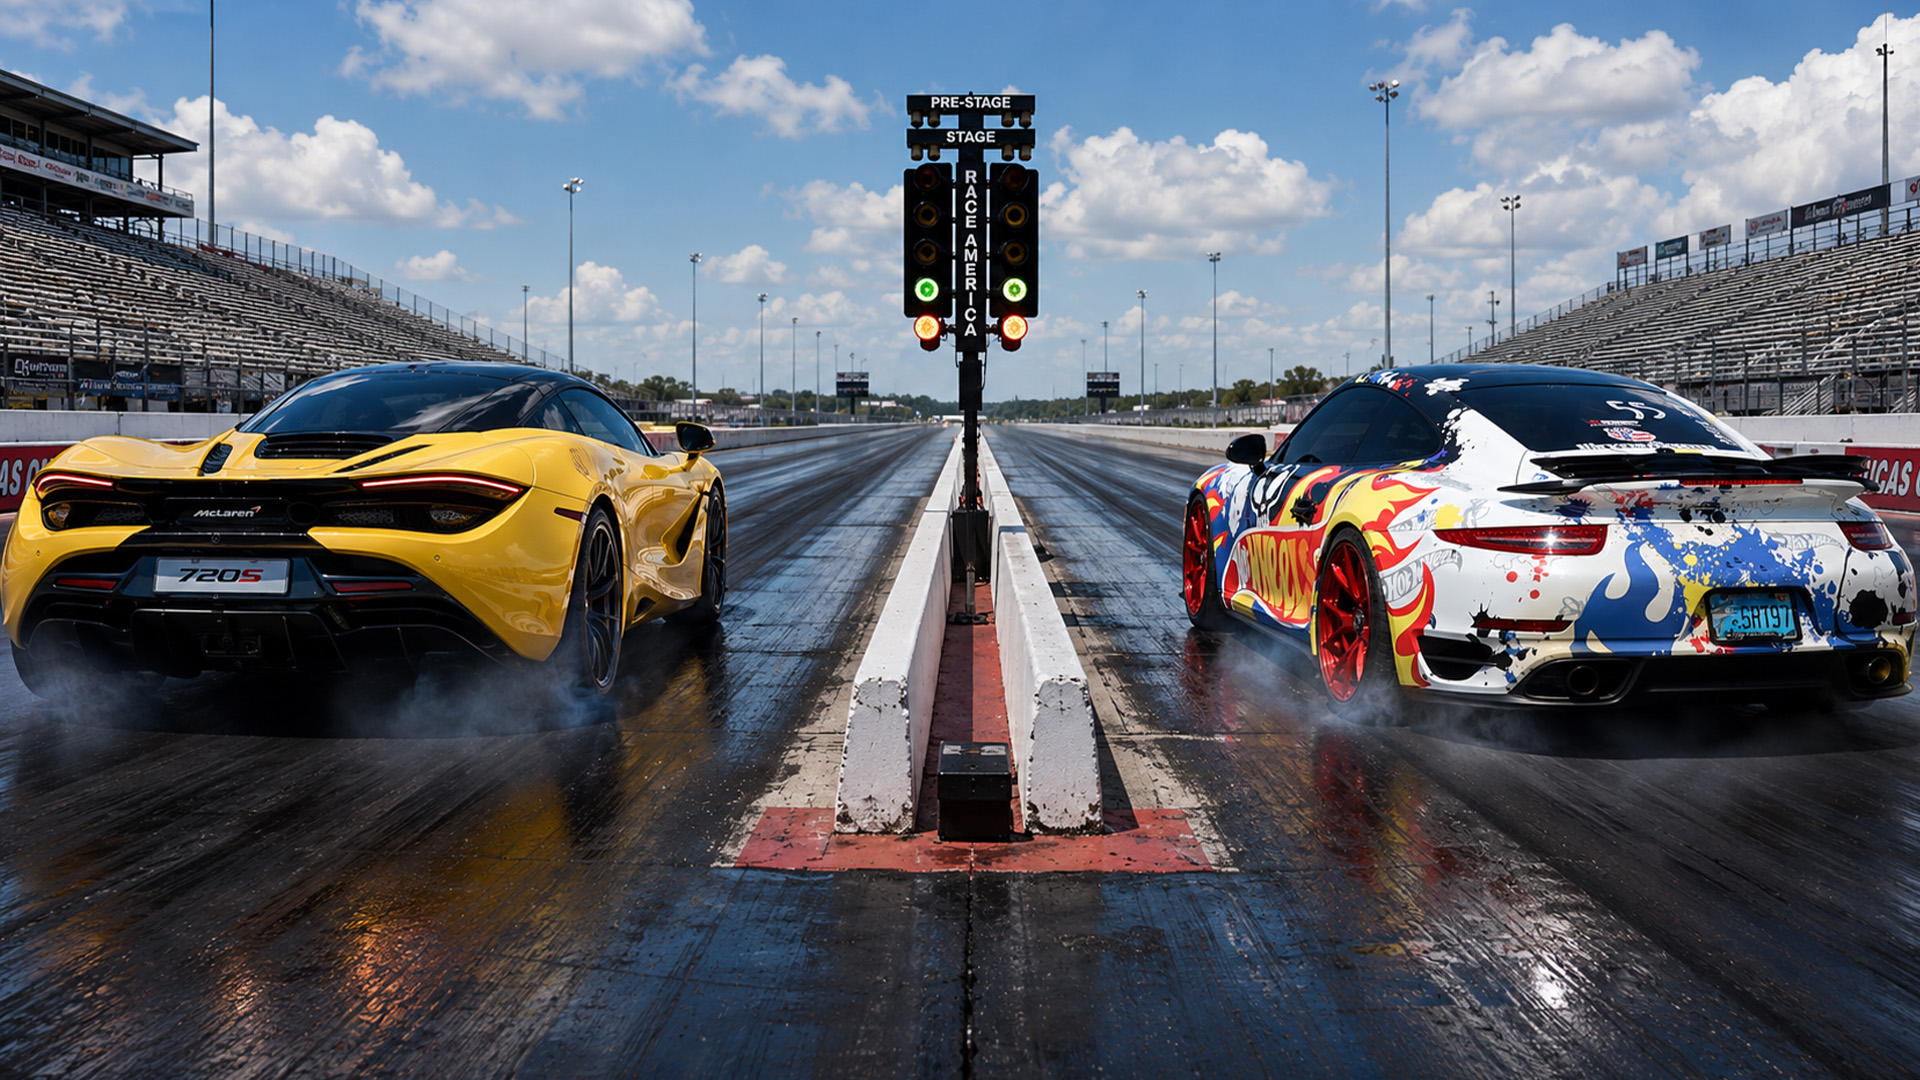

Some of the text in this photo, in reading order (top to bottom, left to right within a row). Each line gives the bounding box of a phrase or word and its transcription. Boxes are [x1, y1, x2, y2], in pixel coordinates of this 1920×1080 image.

[931, 96, 1011, 109] PRE-STAGE
[946, 131, 996, 143] STAGE
[964, 170, 978, 337] RACE AMERICA
[193, 508, 255, 518] McLaren
[178, 568, 264, 583] 720S
